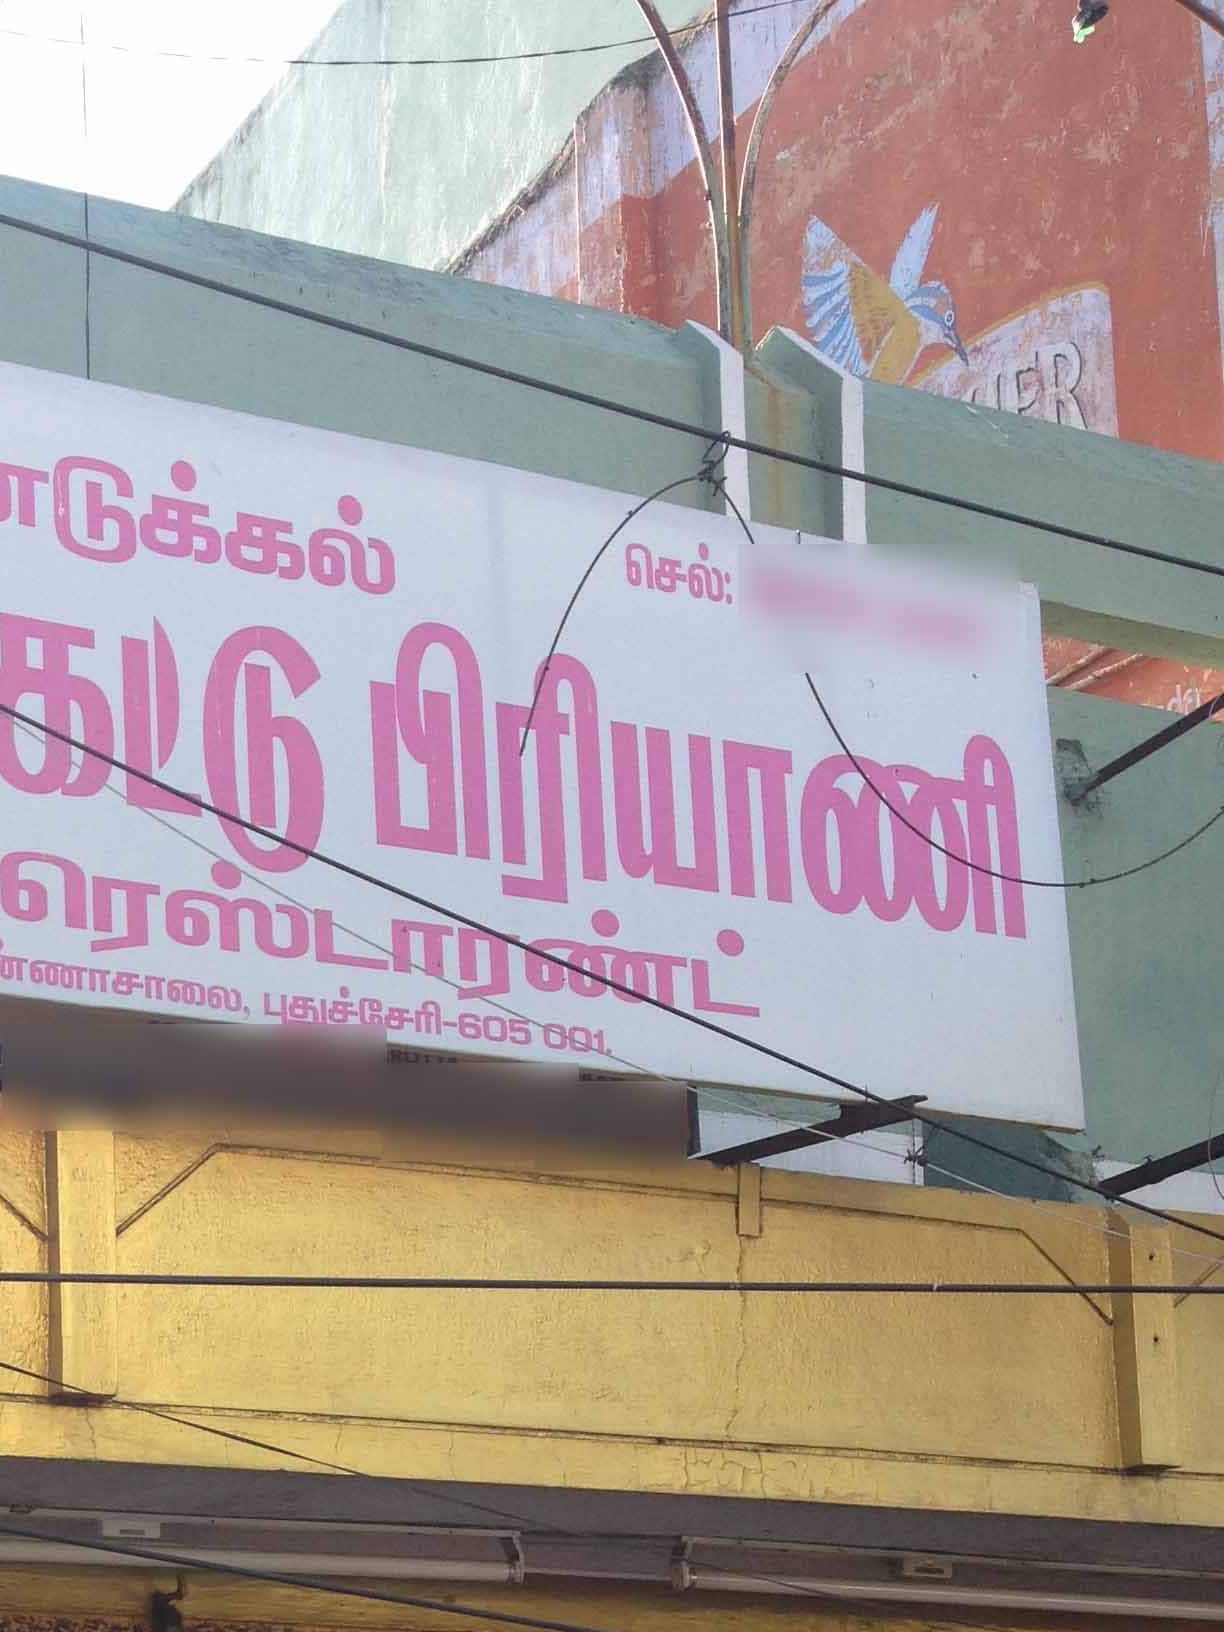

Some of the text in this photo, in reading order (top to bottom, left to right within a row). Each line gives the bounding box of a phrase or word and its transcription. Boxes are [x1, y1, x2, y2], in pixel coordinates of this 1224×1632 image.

[625, 541, 733, 605] செல்:
[369, 622, 1027, 940] பிரியாணி
[0, 845, 761, 1019] ரெஸ்டாரண்ட்
